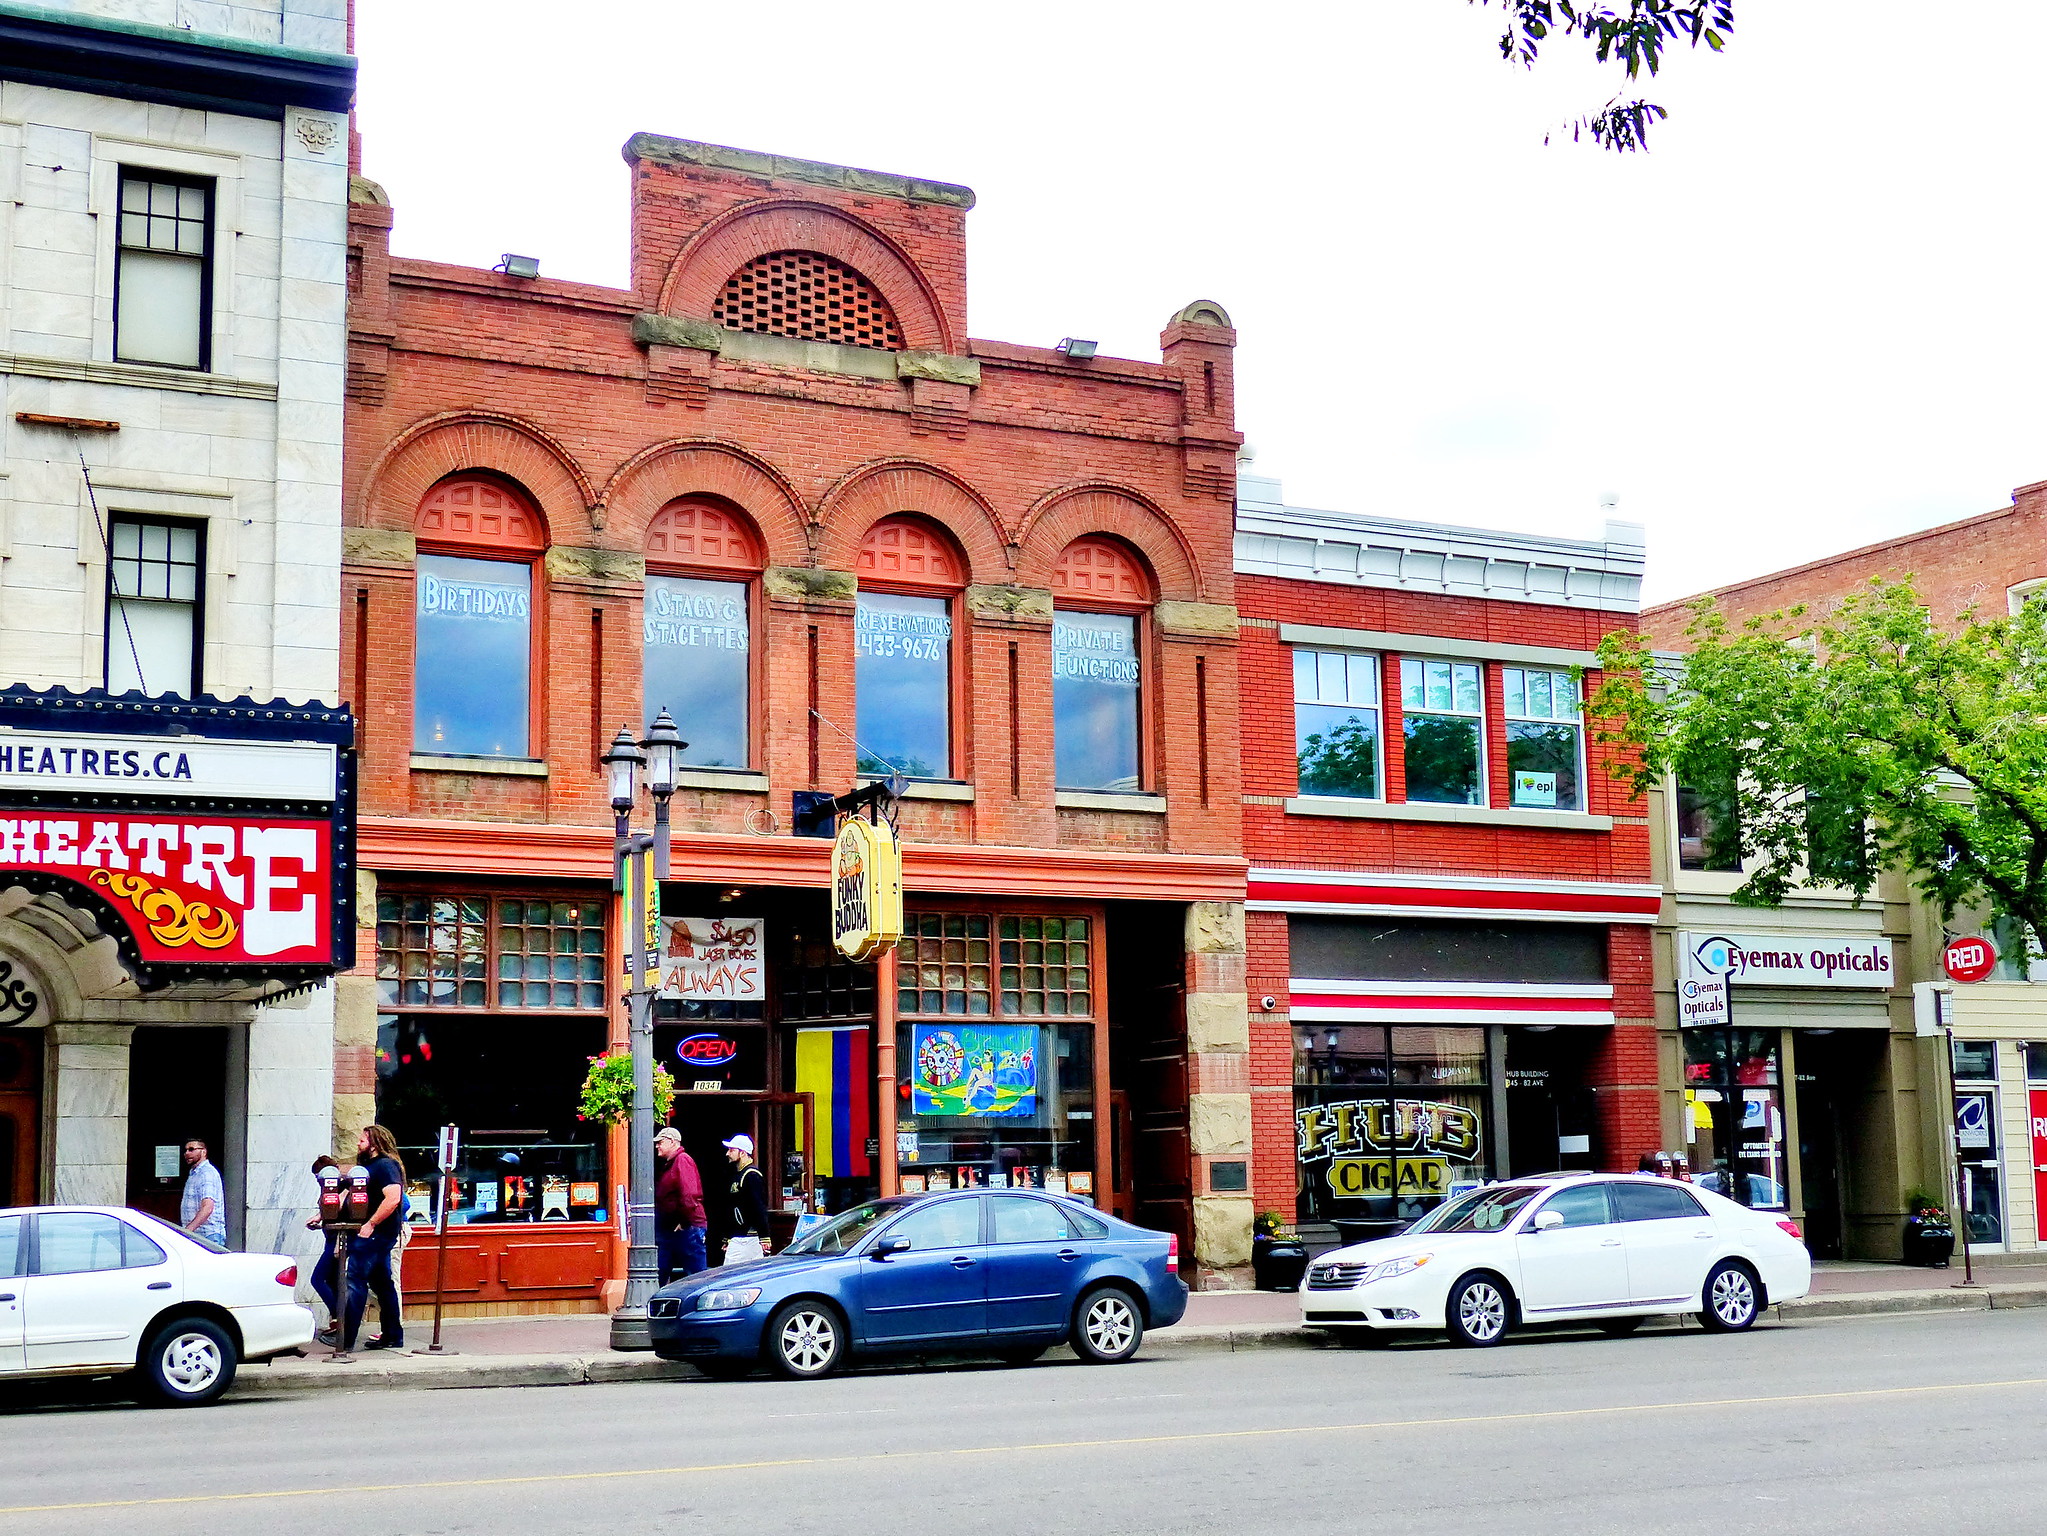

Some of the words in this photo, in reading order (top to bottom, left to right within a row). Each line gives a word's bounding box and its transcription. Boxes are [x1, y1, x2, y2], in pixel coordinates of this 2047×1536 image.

[425, 576, 528, 616] BIRTHDAYS
[657, 588, 715, 618] STAGS
[722, 599, 738, 620] &
[644, 618, 748, 650] STAGETTES
[857, 605, 951, 636] RESERVATIONS
[861, 633, 940, 660] 433-9676
[1055, 622, 1123, 651] PRIVATE
[1055, 650, 1139, 679] FUNCTIONS
[1517, 779, 1521, 790] I
[1536, 781, 1554, 794] epl
[838, 871, 865, 908] FUNKY
[835, 900, 868, 940] BUDDHA
[1728, 947, 1804, 976] Eyemax
[1810, 945, 1889, 979] Opticals
[1947, 944, 1985, 970] RED
[664, 963, 757, 996] ALWAYS
[1693, 983, 1723, 998] Eyemax
[1684, 995, 1724, 1019] Opticals
[680, 1040, 737, 1057] OPEN
[695, 1082, 721, 1090] 10341
[1505, 1070, 1519, 1078] HUB
[1520, 1070, 1549, 1078] BUILDING
[1296, 1098, 1481, 1164] HUB
[1339, 1162, 1442, 1192] CIGAR
